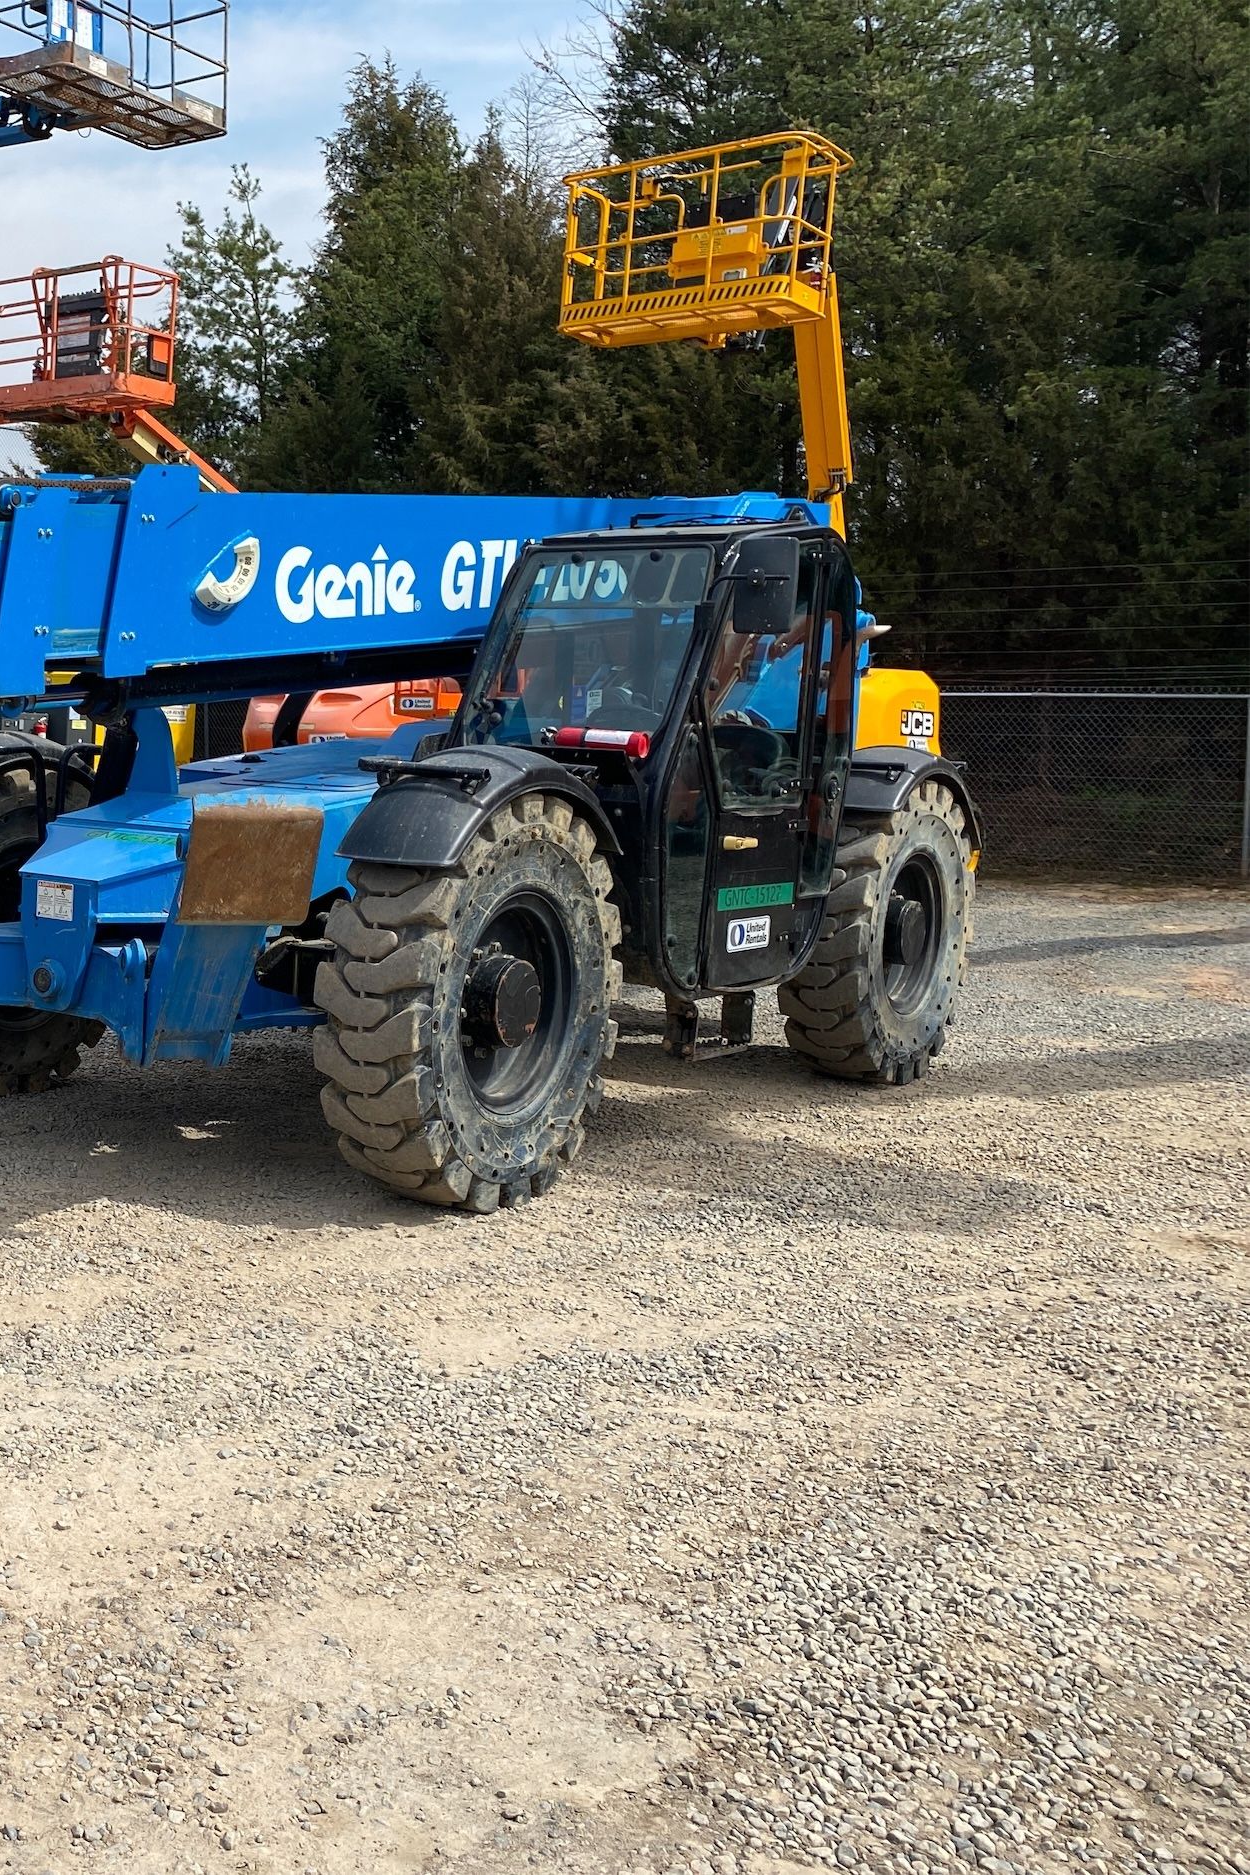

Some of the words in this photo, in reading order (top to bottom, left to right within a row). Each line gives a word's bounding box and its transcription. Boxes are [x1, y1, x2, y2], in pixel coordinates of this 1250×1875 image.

[275, 544, 417, 624] Genie
[901, 711, 934, 736] JCB
[746, 921, 767, 933] United
[745, 932, 767, 945] Rentals
